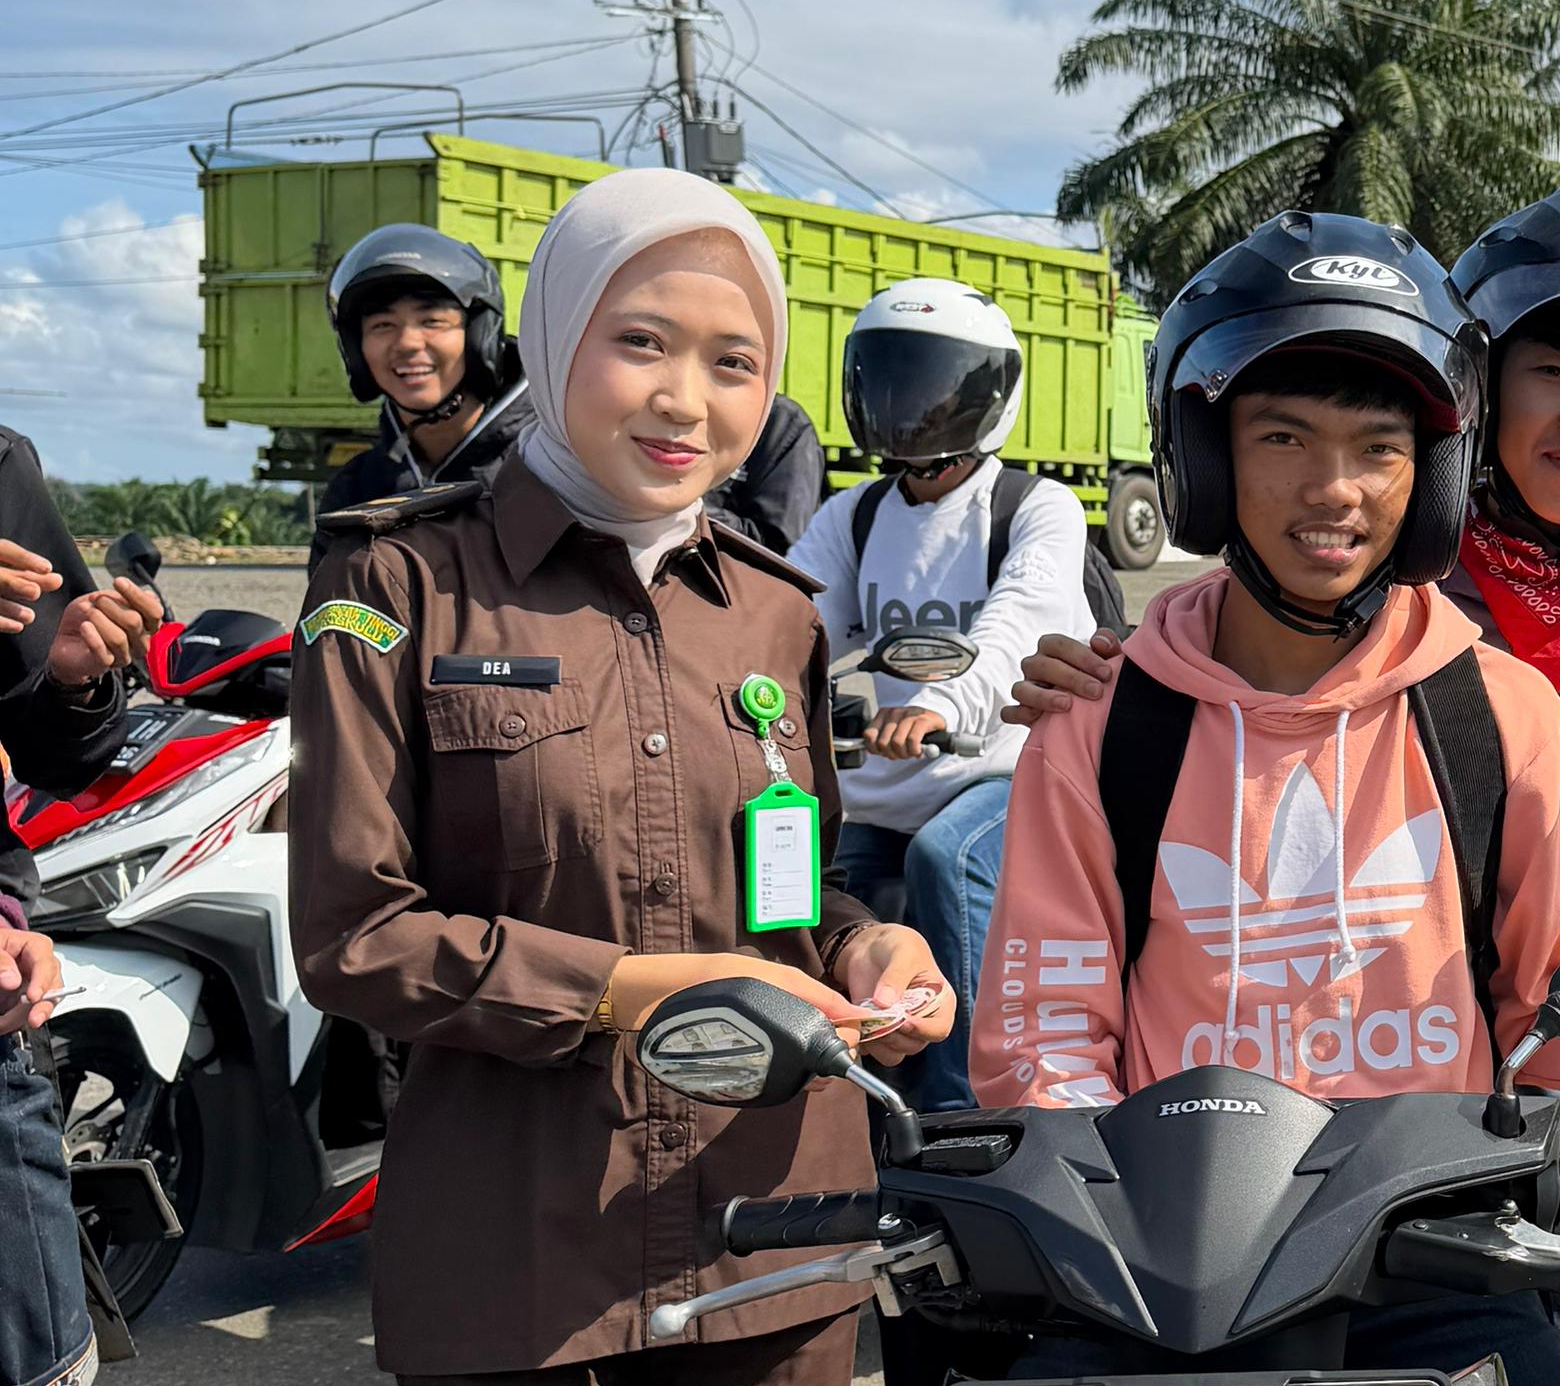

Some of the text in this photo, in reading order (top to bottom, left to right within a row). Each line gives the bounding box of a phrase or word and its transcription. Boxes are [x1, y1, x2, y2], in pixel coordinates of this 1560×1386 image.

[483, 661, 511, 675] DEA
[1001, 938, 1028, 1051] CLOUDS
[1181, 996, 1460, 1080] adidas
[1158, 1099, 1267, 1117] HONDA
